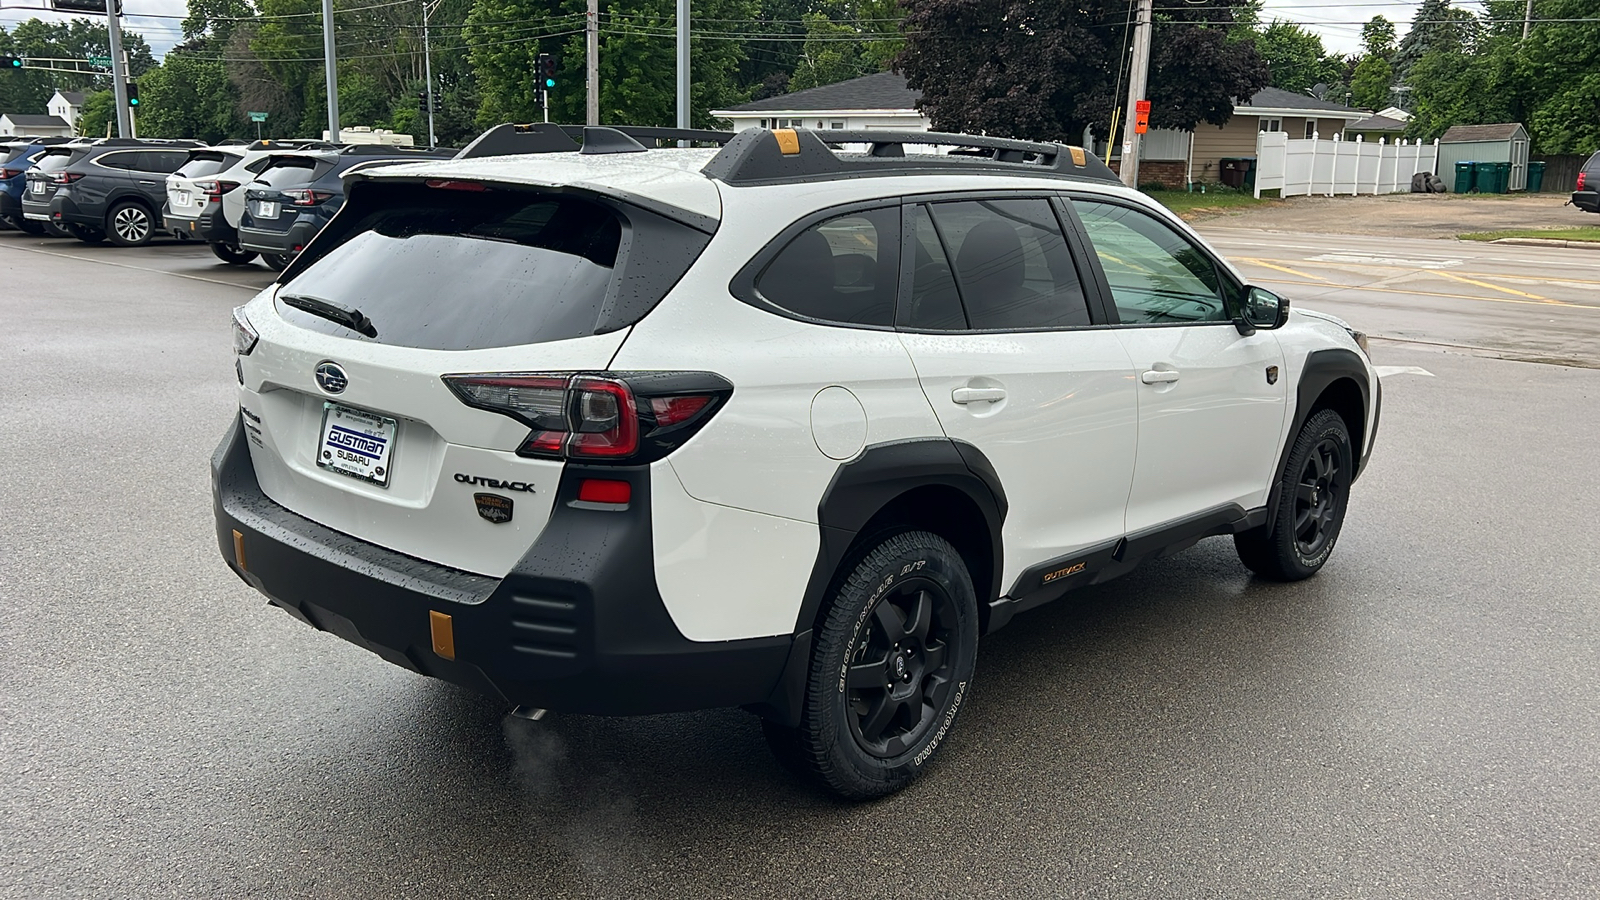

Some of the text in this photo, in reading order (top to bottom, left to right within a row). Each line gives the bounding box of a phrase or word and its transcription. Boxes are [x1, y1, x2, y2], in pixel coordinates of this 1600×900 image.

[337, 450, 370, 466] SUBARU
[453, 473, 536, 493] OUTBACK
[476, 498, 509, 508] WILDERNESS
[1044, 561, 1086, 581] OUTBACK
[838, 560, 926, 693] GEOLANDAR A/T
[914, 681, 967, 766] YOKOHAMA
